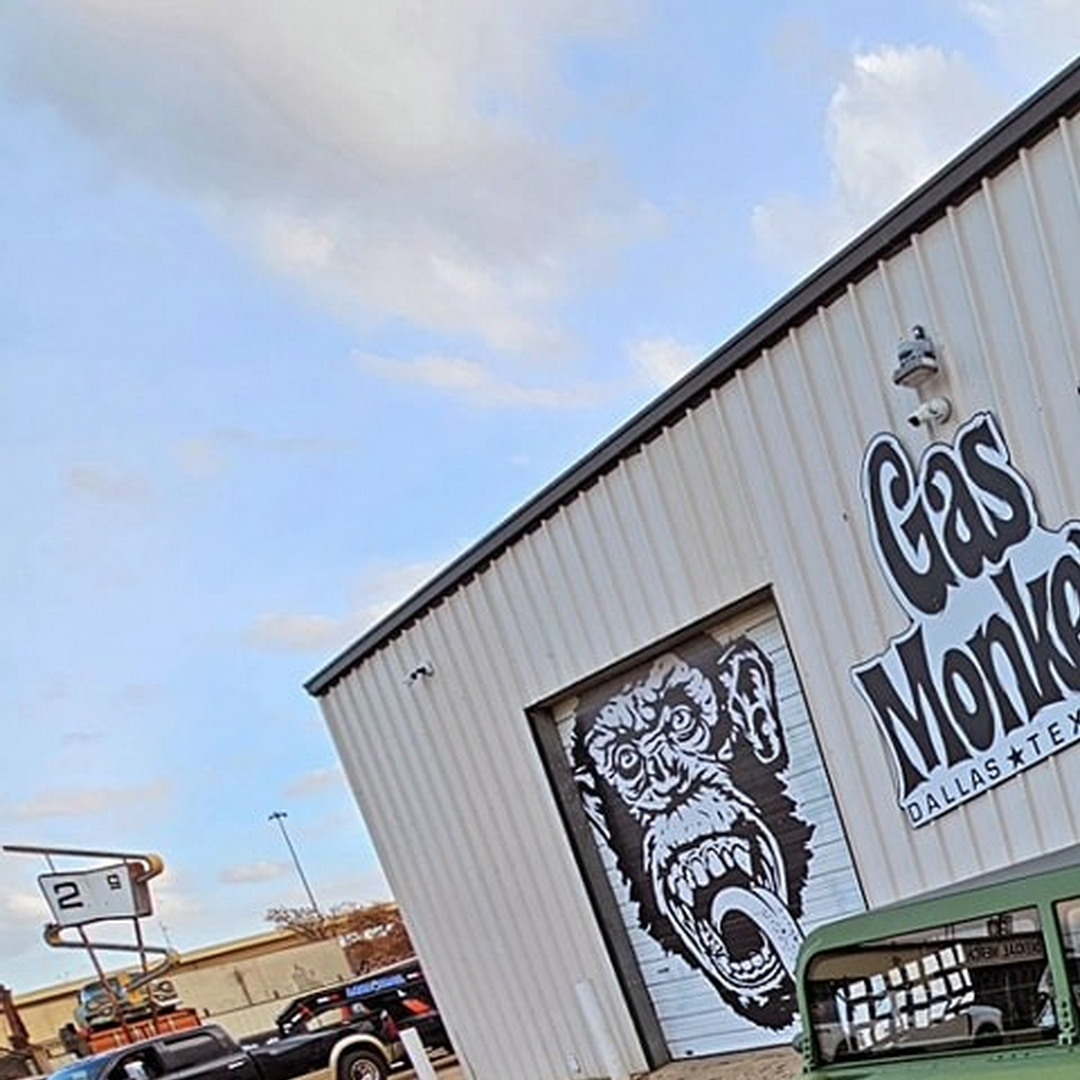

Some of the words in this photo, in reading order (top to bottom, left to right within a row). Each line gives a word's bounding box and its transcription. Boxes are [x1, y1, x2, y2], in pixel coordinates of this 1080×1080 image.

[868, 420, 1031, 613] Gas
[906, 758, 1002, 822] DALLAS
[53, 881, 84, 910] 2
